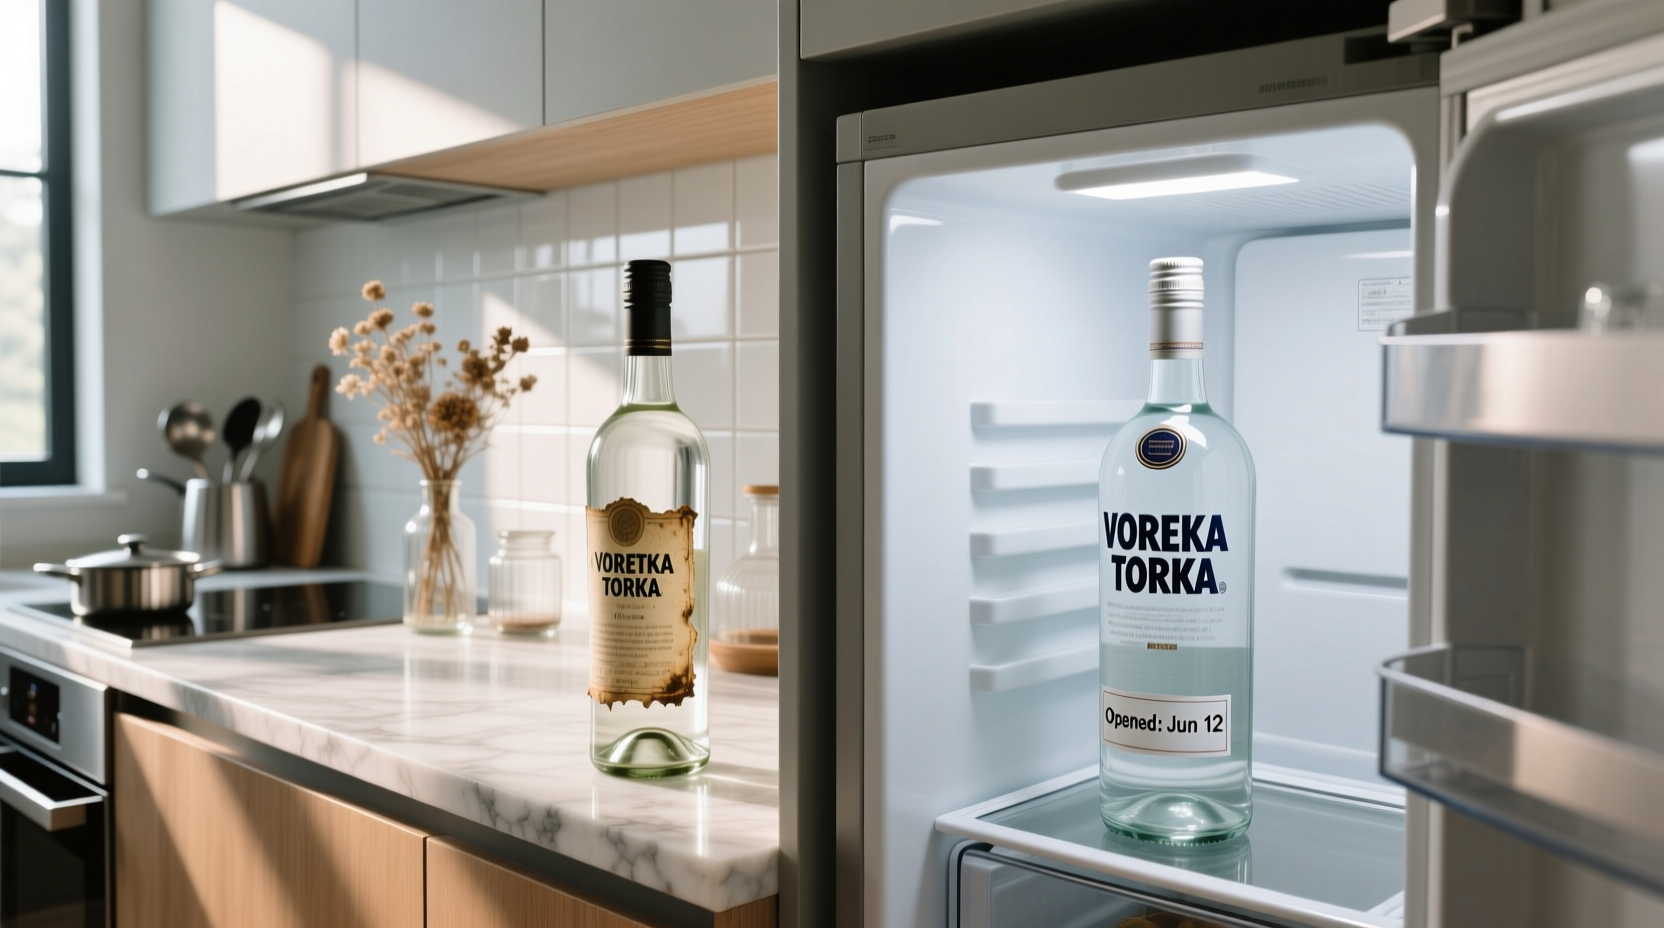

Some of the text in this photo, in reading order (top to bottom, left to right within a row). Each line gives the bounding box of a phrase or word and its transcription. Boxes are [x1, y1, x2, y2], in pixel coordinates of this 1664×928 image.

[1103, 511, 1229, 552] VOREKA
[594, 551, 675, 574] VORETKA
[1111, 554, 1219, 594] TORKA
[602, 577, 662, 597] TORKA
[1105, 707, 1224, 733] Opened: Jun 12
